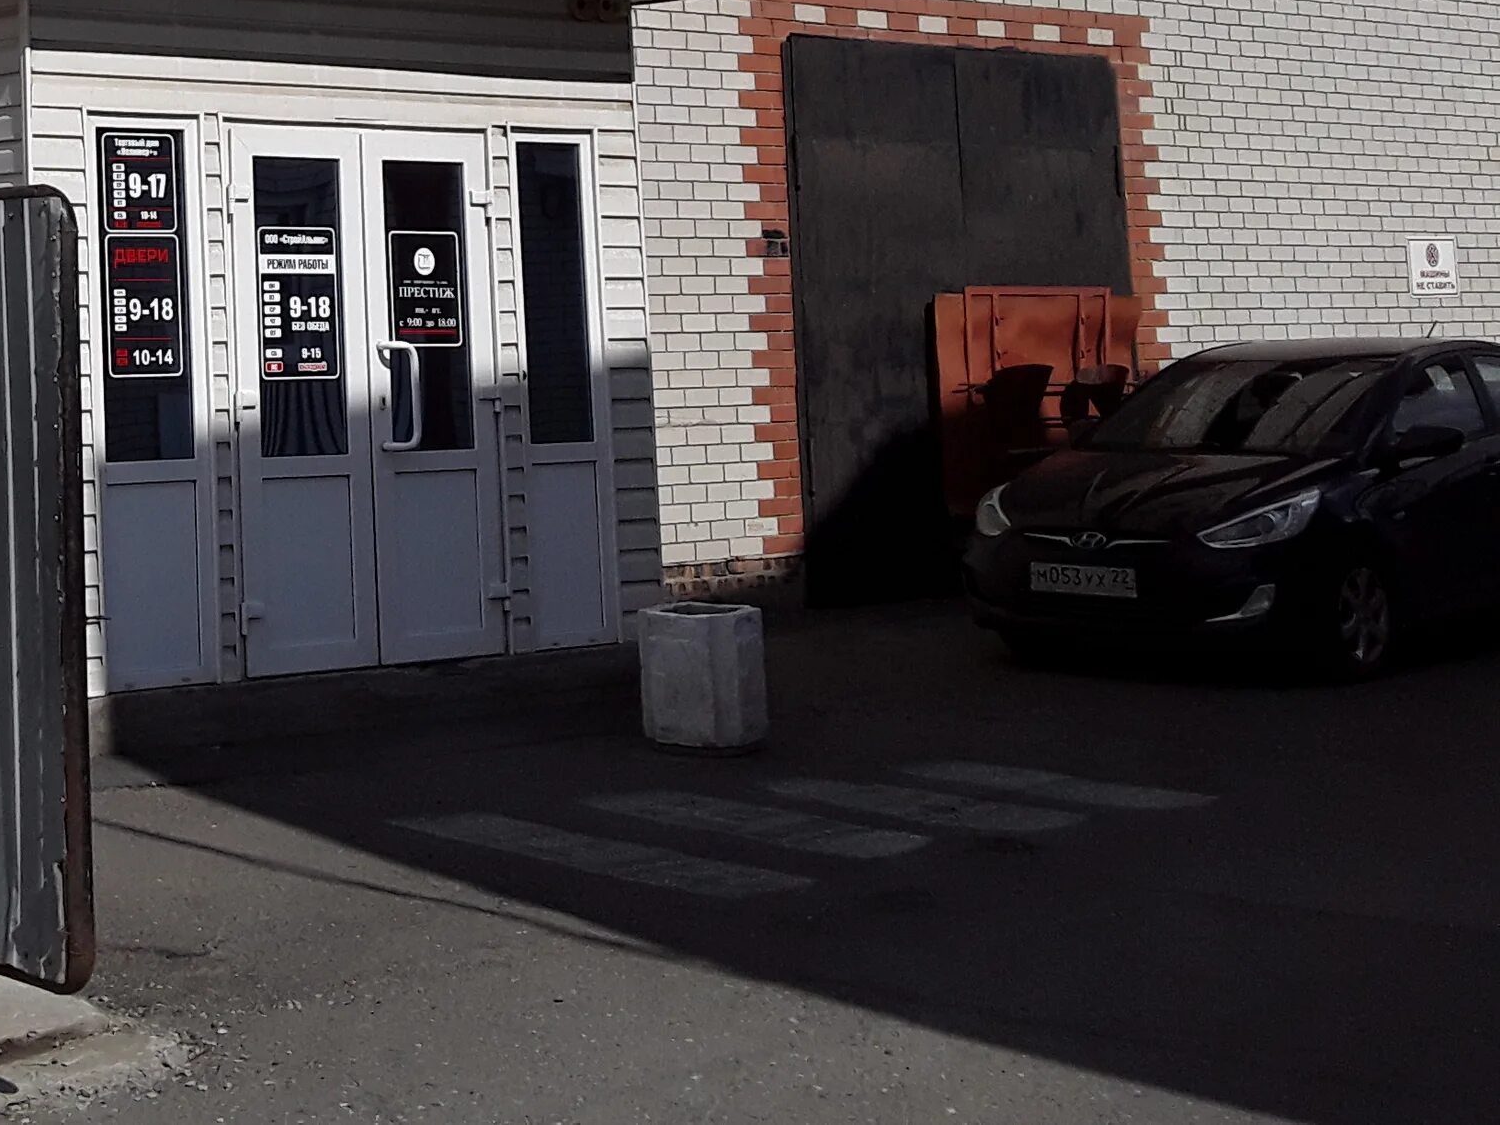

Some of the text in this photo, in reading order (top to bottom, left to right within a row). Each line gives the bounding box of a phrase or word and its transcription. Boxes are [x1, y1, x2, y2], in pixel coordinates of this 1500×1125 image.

[128, 173, 167, 199] 9-17
[113, 248, 169, 269] ДВЕРИ
[266, 258, 329, 270] РЕЖИМ РАБОТЫ
[398, 286, 456, 299] ПРЕСТИЖ
[129, 297, 174, 321] 9-18
[289, 295, 331, 318] 9-18
[132, 348, 174, 366] 10-14
[1111, 569, 1131, 584] 22
